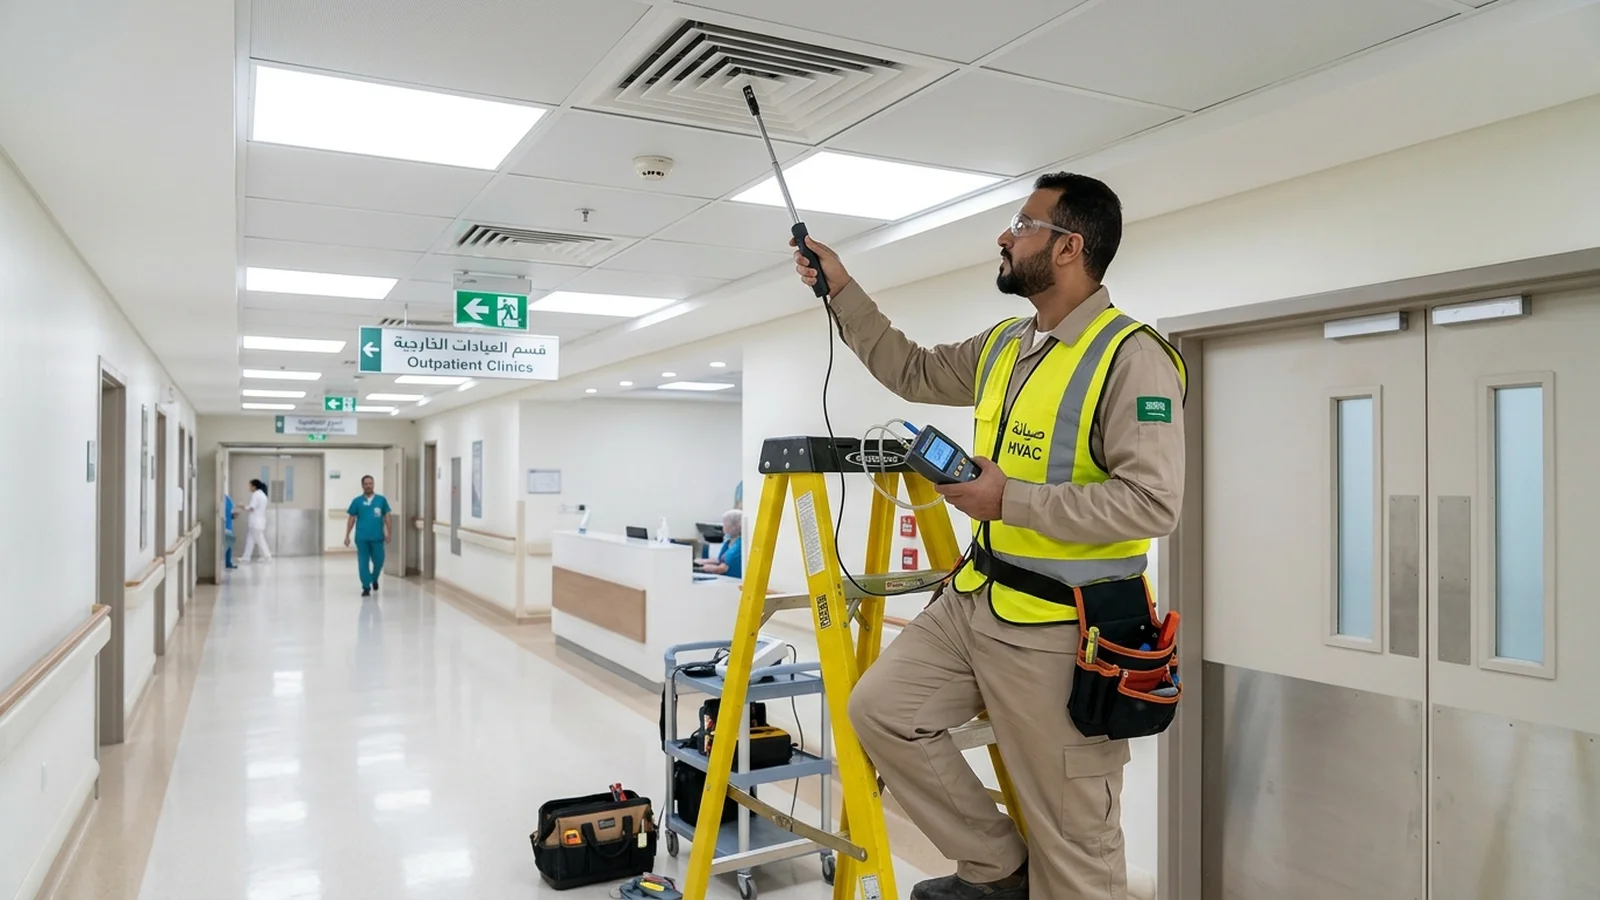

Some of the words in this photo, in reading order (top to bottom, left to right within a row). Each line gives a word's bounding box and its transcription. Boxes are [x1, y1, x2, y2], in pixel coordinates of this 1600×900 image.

[394, 335, 448, 353] الخارجية
[452, 339, 507, 355] العيادات
[511, 345, 546, 358] قسم
[407, 356, 482, 372] Outpatient
[486, 360, 533, 373] Clinics
[1007, 441, 1042, 461] HVAC
